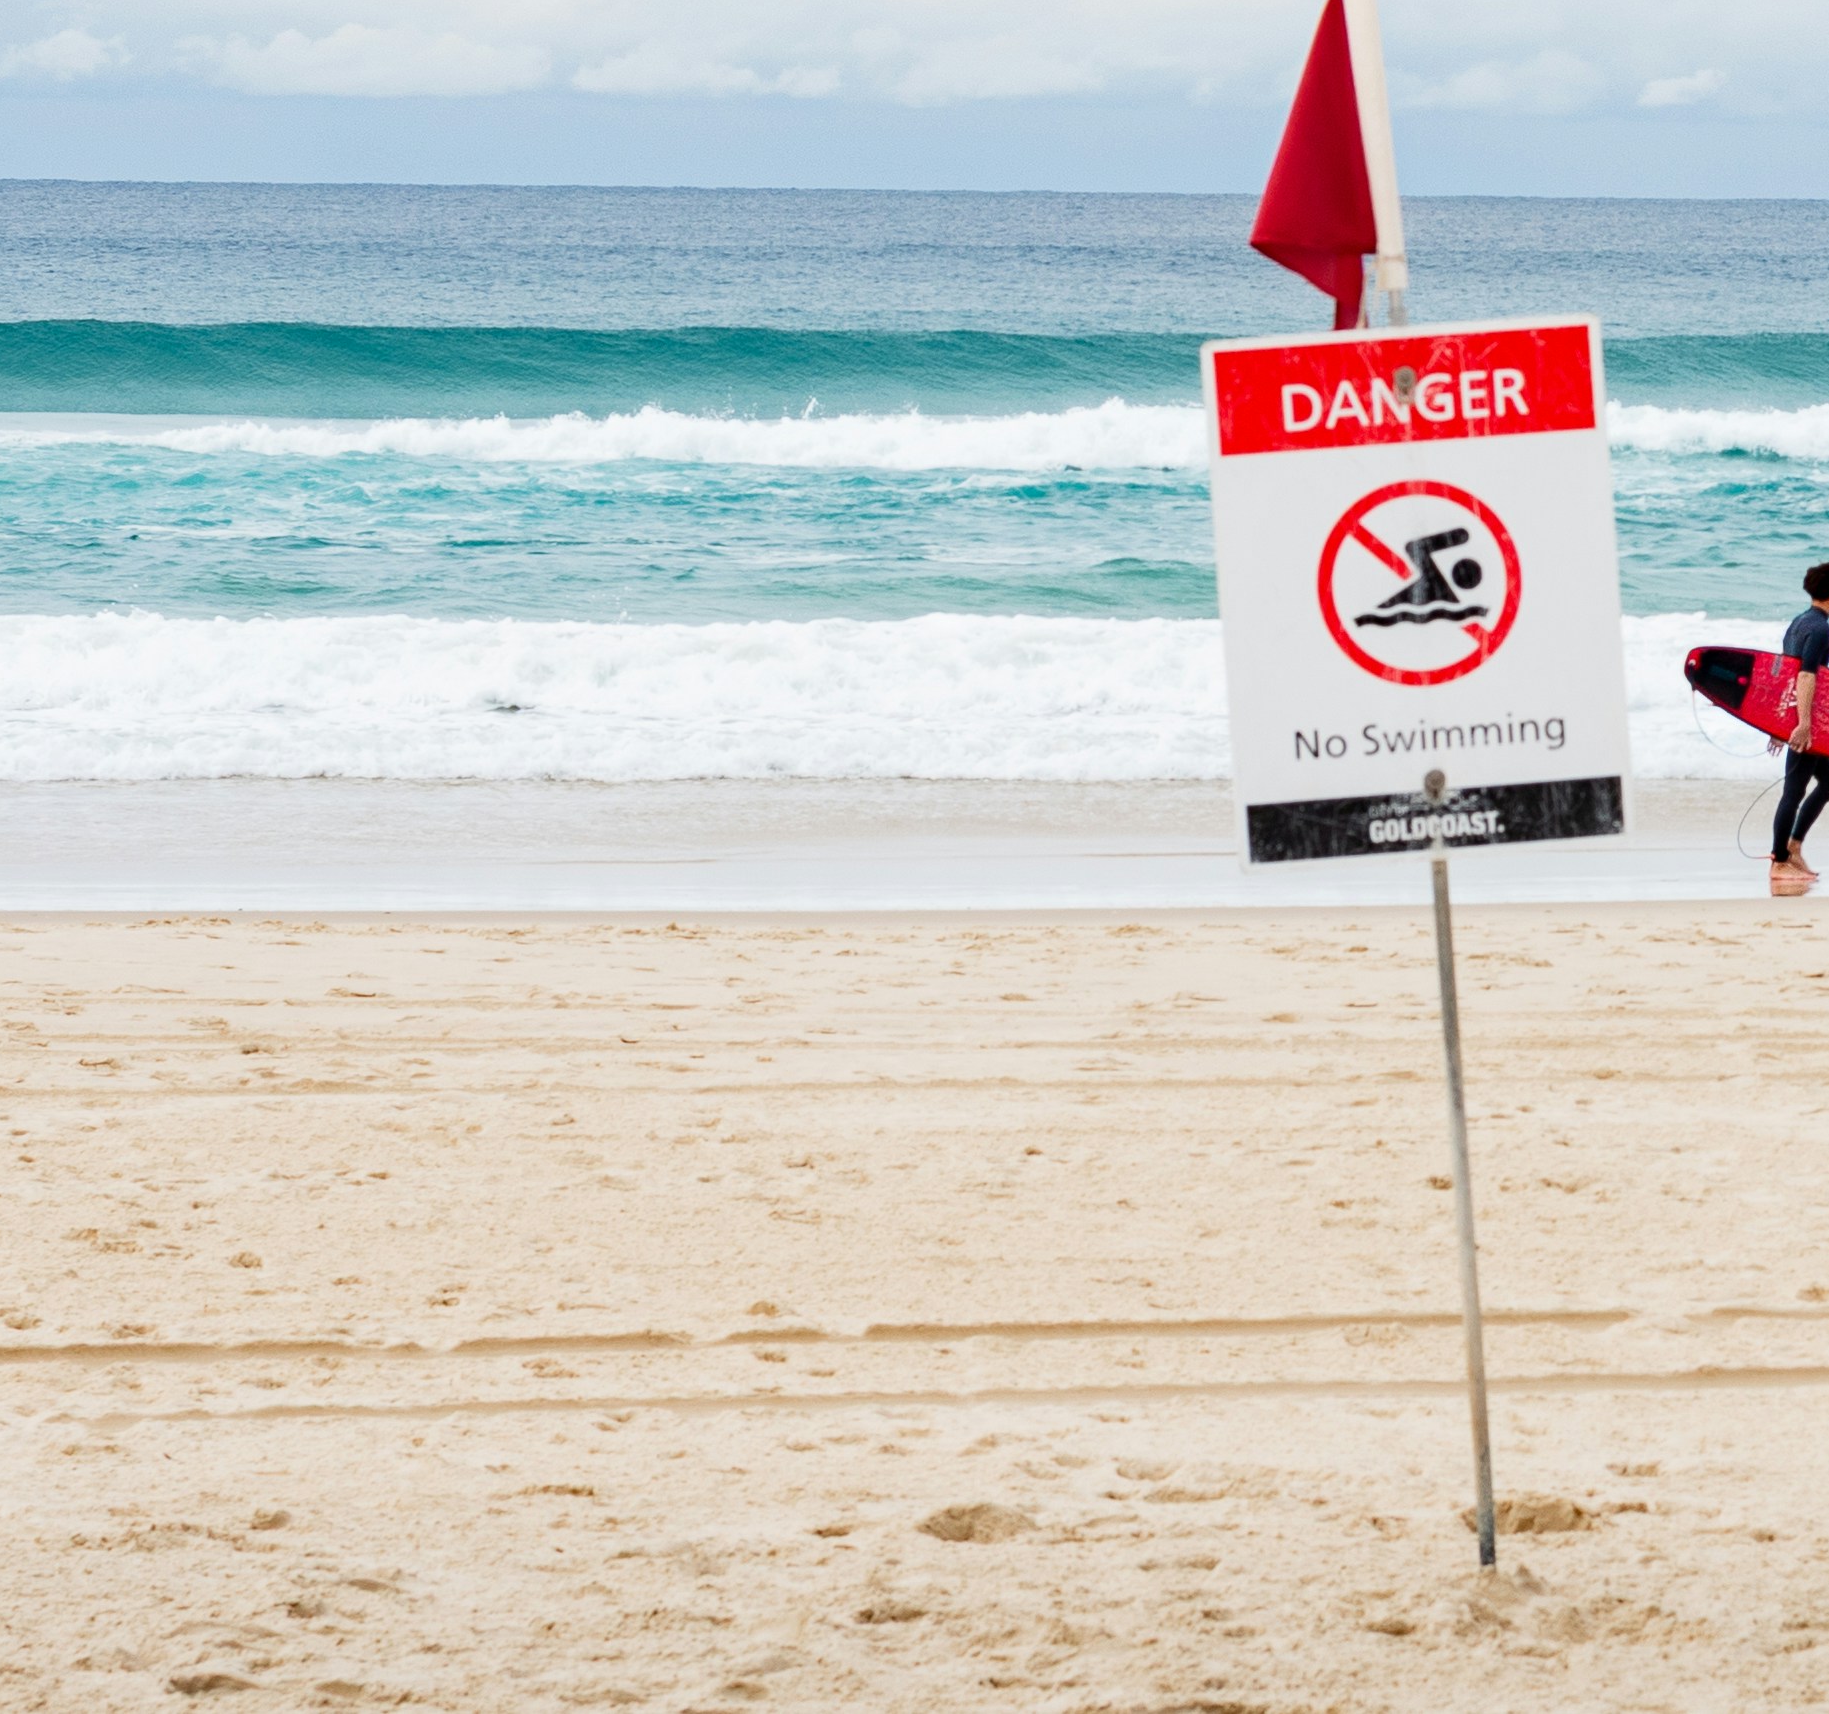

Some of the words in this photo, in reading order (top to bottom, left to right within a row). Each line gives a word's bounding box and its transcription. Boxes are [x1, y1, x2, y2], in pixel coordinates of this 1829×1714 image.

[1281, 368, 1530, 433] DANGER
[1294, 729, 1347, 760] No
[1362, 712, 1566, 756] Swimming
